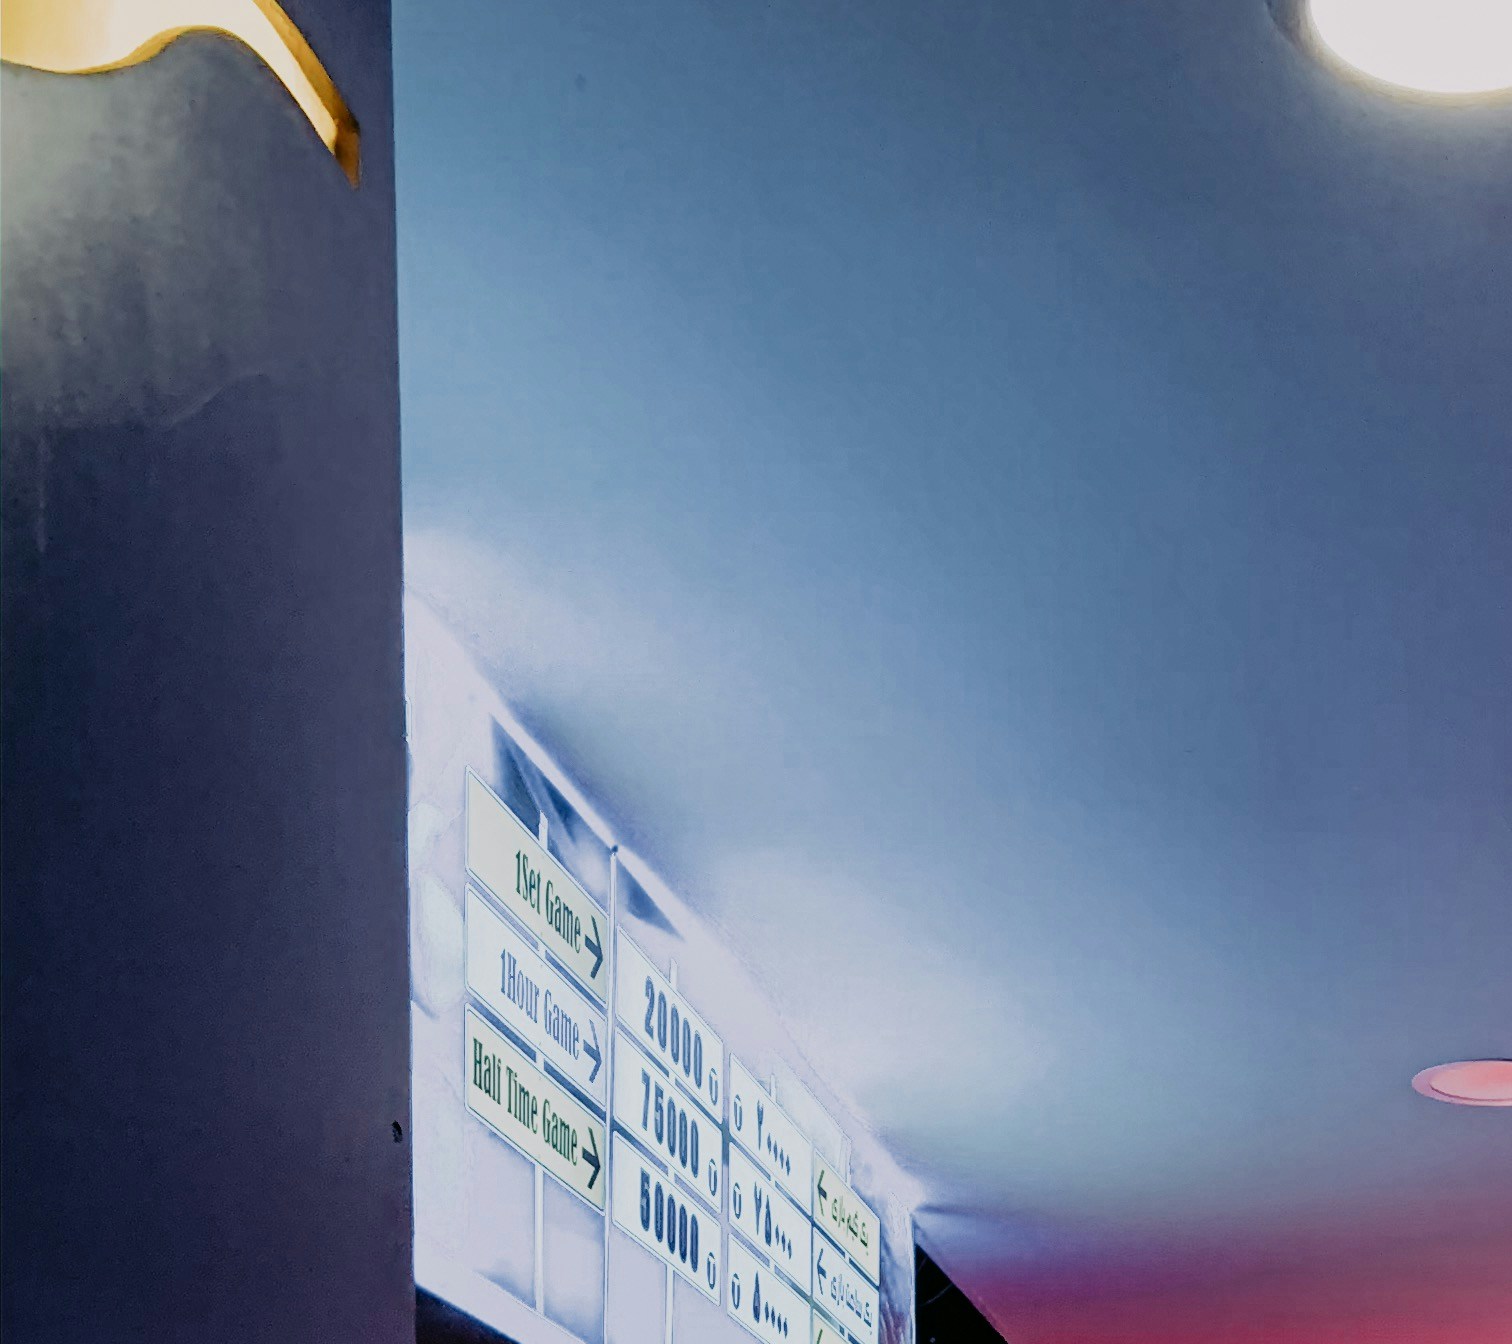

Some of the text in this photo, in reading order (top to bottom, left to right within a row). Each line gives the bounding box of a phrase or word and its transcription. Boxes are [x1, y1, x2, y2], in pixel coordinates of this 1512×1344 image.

[545, 879, 581, 954] Game
[543, 989, 579, 1060] Game
[645, 976, 702, 1089] 20000
[506, 1065, 538, 1134] Time
[542, 1098, 578, 1166] Game
[641, 1067, 699, 1179] 75000
[639, 1166, 699, 1273] 50000
